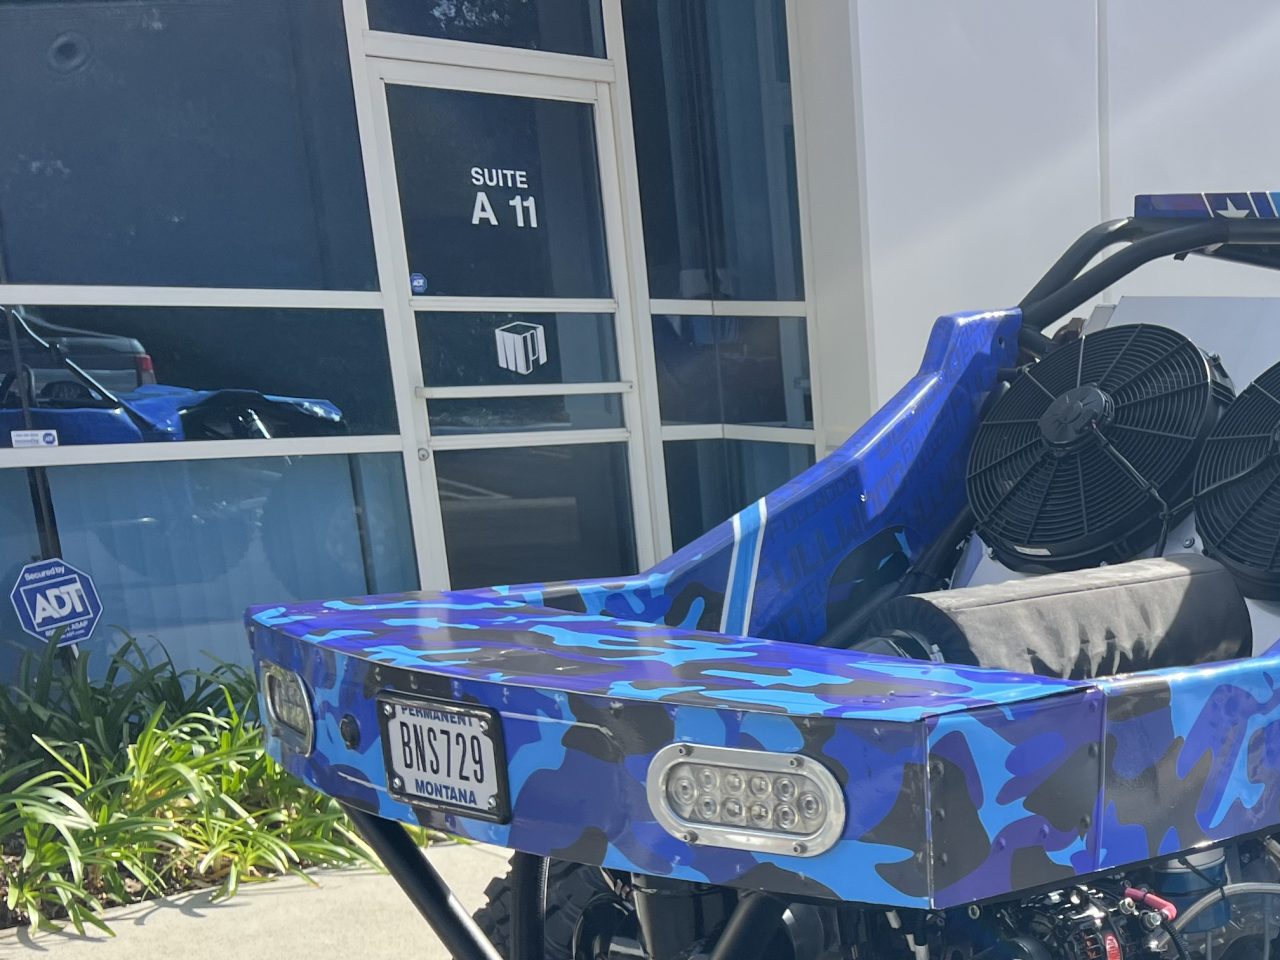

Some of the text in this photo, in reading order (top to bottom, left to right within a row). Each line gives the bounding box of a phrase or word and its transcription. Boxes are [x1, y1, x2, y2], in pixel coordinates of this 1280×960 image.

[471, 167, 528, 188] SUITE
[471, 191, 538, 228] A 11
[24, 567, 55, 581] Secured
[35, 582, 84, 624] ADT
[399, 720, 485, 784] BNS729
[415, 778, 478, 806] MONTANA
